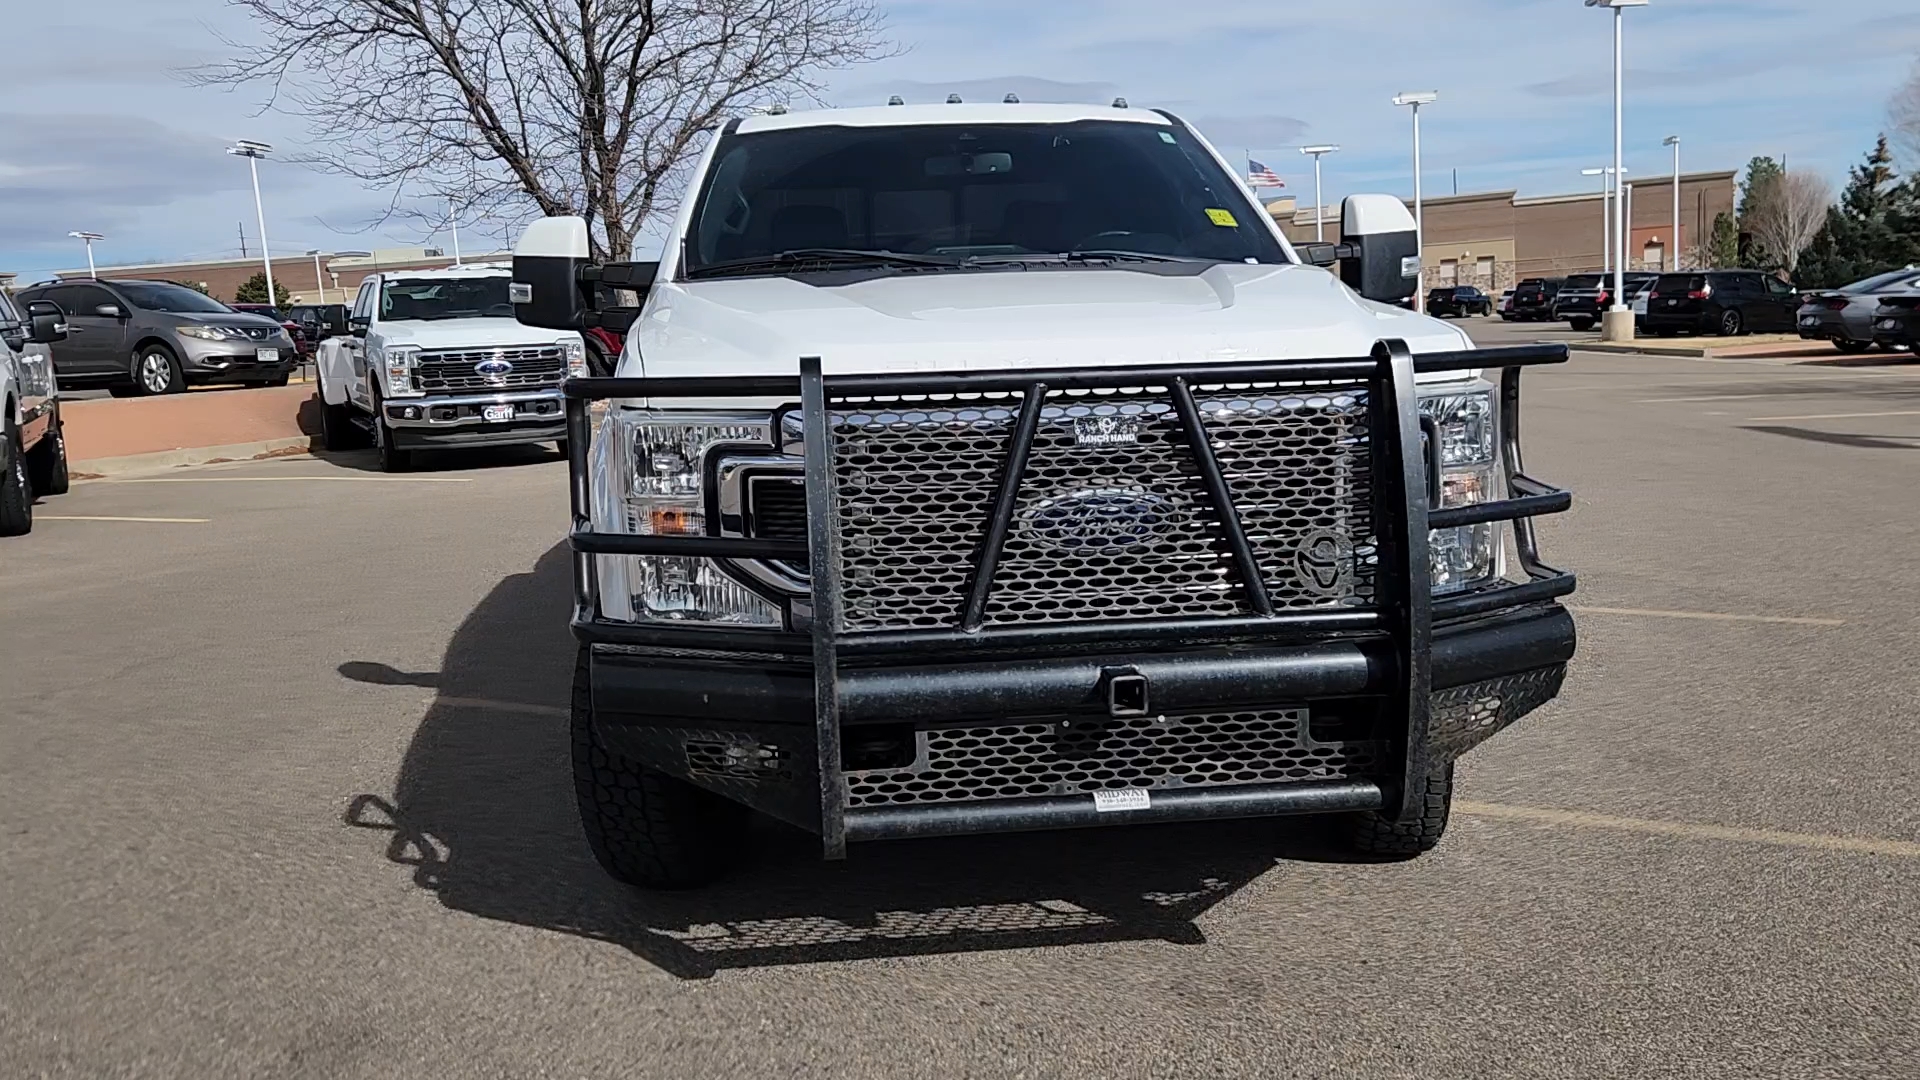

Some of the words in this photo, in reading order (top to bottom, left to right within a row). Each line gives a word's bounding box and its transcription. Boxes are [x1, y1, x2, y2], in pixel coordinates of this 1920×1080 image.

[1079, 433, 1109, 444] RANCH
[1111, 432, 1136, 443] HAND
[1097, 788, 1145, 799] MIDWAY
